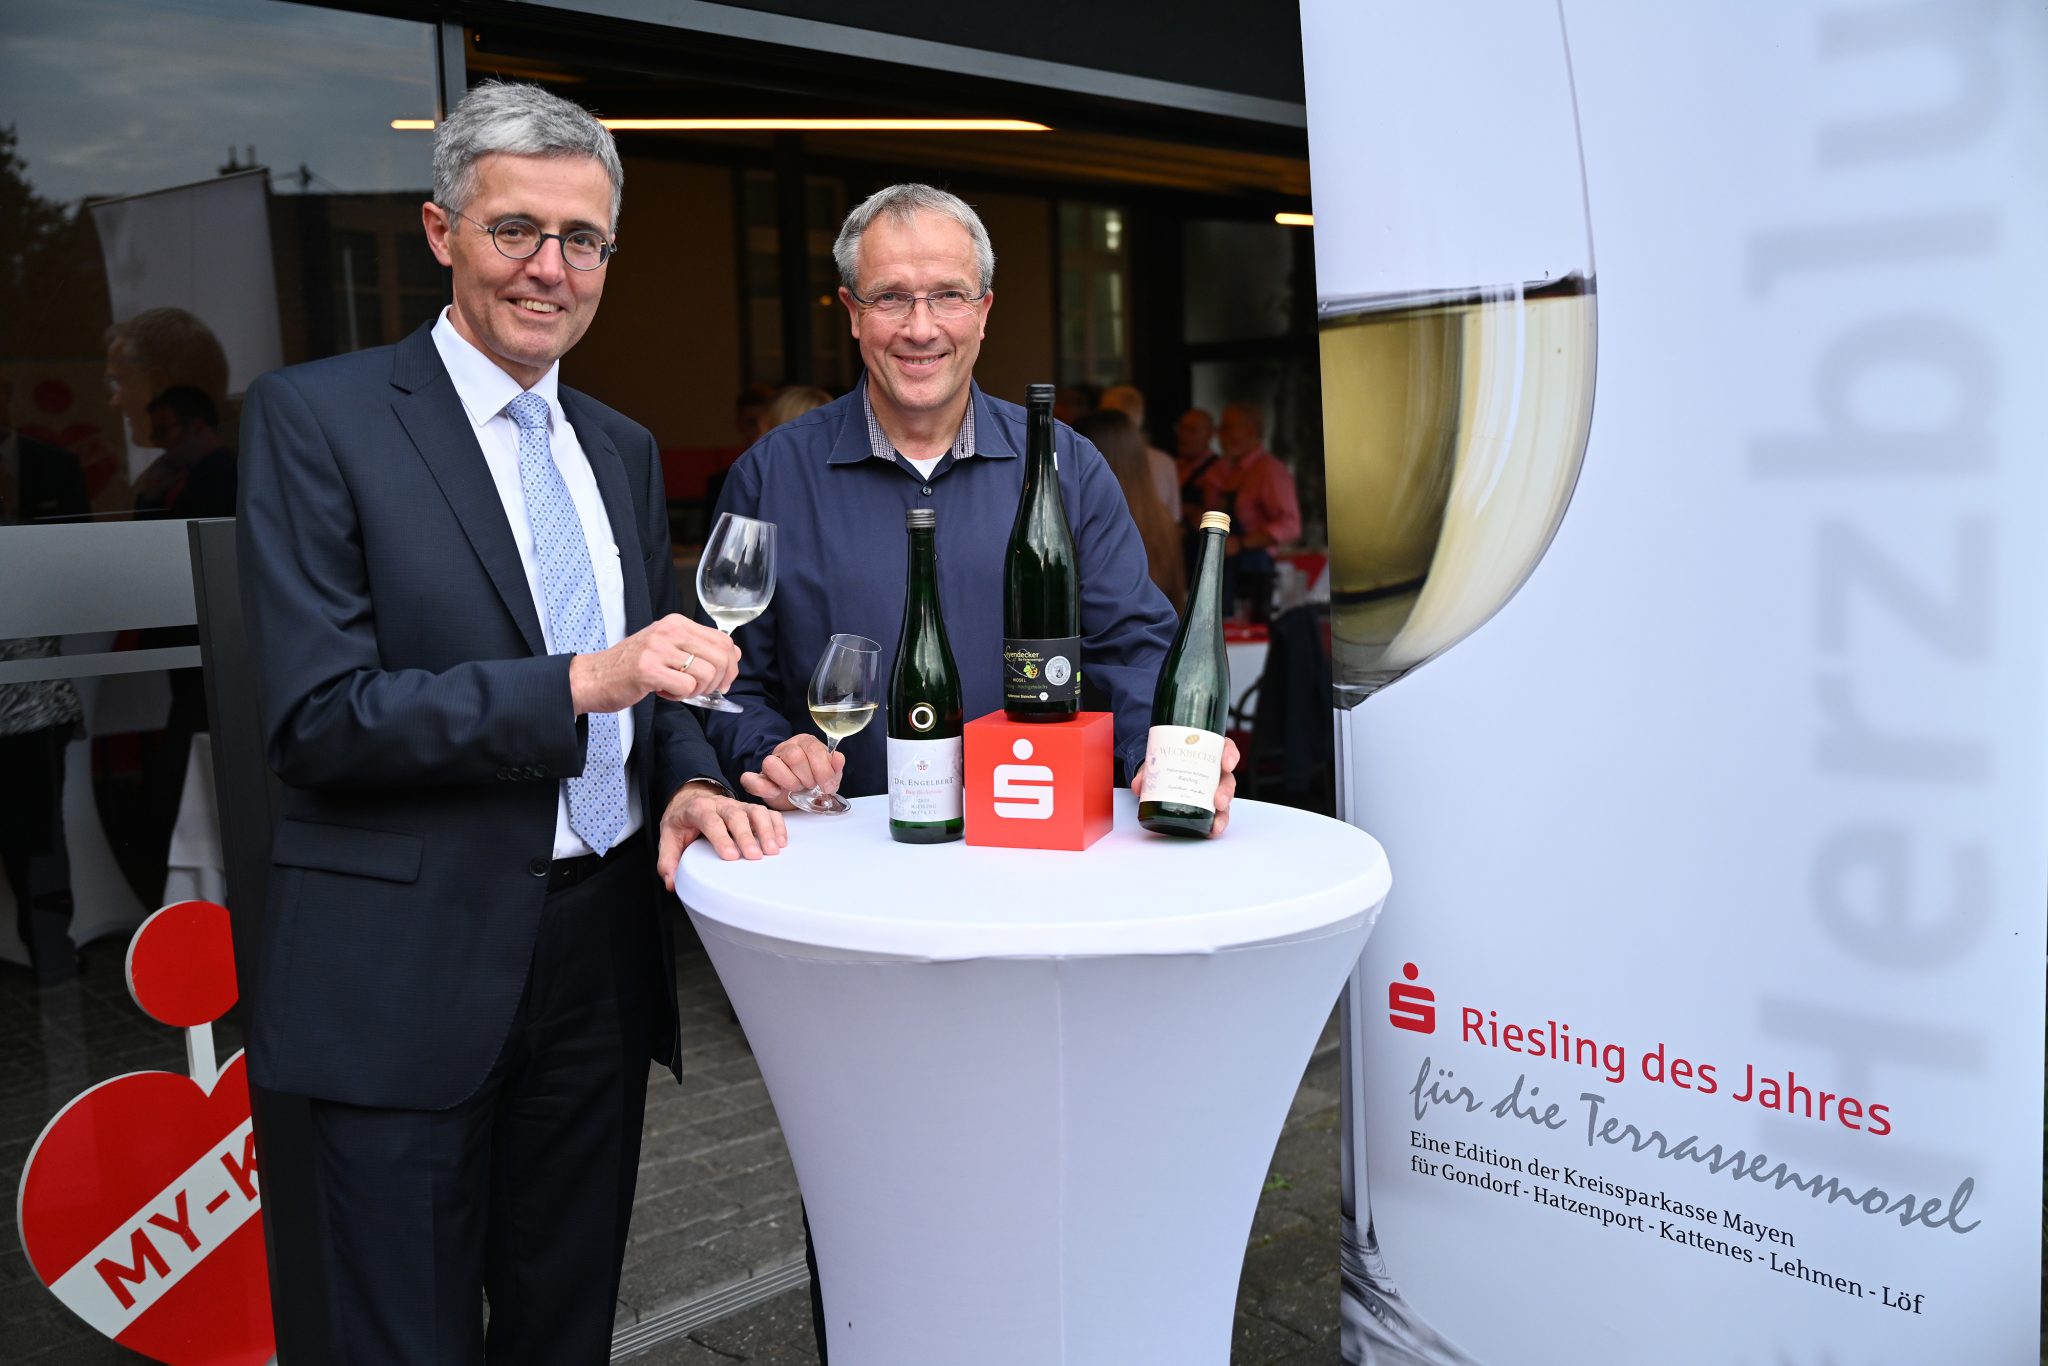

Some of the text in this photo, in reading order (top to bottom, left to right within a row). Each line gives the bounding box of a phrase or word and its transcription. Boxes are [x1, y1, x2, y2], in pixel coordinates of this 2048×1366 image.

[908, 776, 954, 787] ENGELBERT
[1462, 1006, 1892, 1136] Riesling des Jahres
[1409, 1056, 1982, 1235] für die Terrassenmosel
[1410, 1130, 1796, 1248] Eine Edition der Kreissparkasse Mayen
[1411, 1154, 1439, 1177] für
[1442, 1163, 1521, 1197] Gondorf
[1533, 1185, 1645, 1233] Hatzenport
[1659, 1220, 1754, 1263] Kattenes
[1769, 1251, 1864, 1298] Lehmen
[1881, 1285, 1925, 1315] Löf
